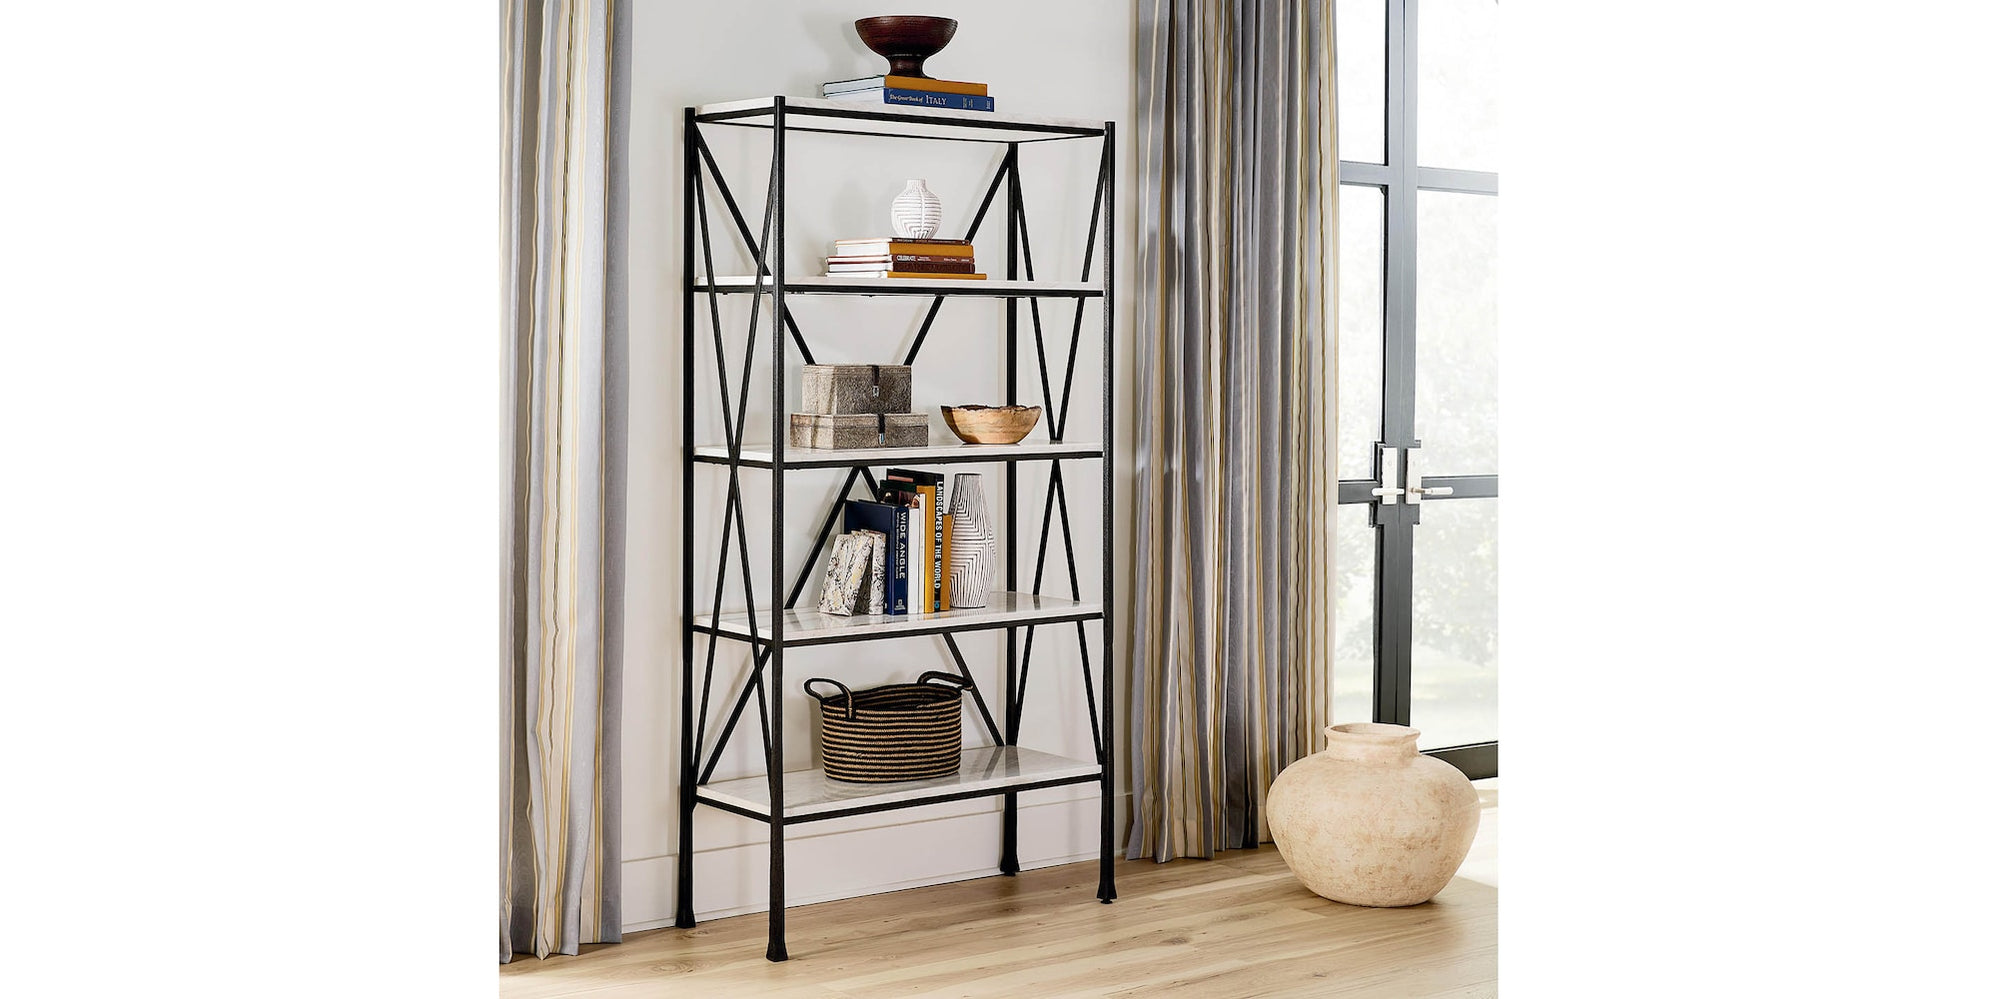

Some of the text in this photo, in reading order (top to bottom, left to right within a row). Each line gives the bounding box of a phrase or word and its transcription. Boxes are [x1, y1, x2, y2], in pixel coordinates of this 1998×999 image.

[926, 94, 946, 105] ITALY
[899, 512, 907, 539] WIDE
[934, 481, 944, 589] LANDSCAPES OF THE WORLD
